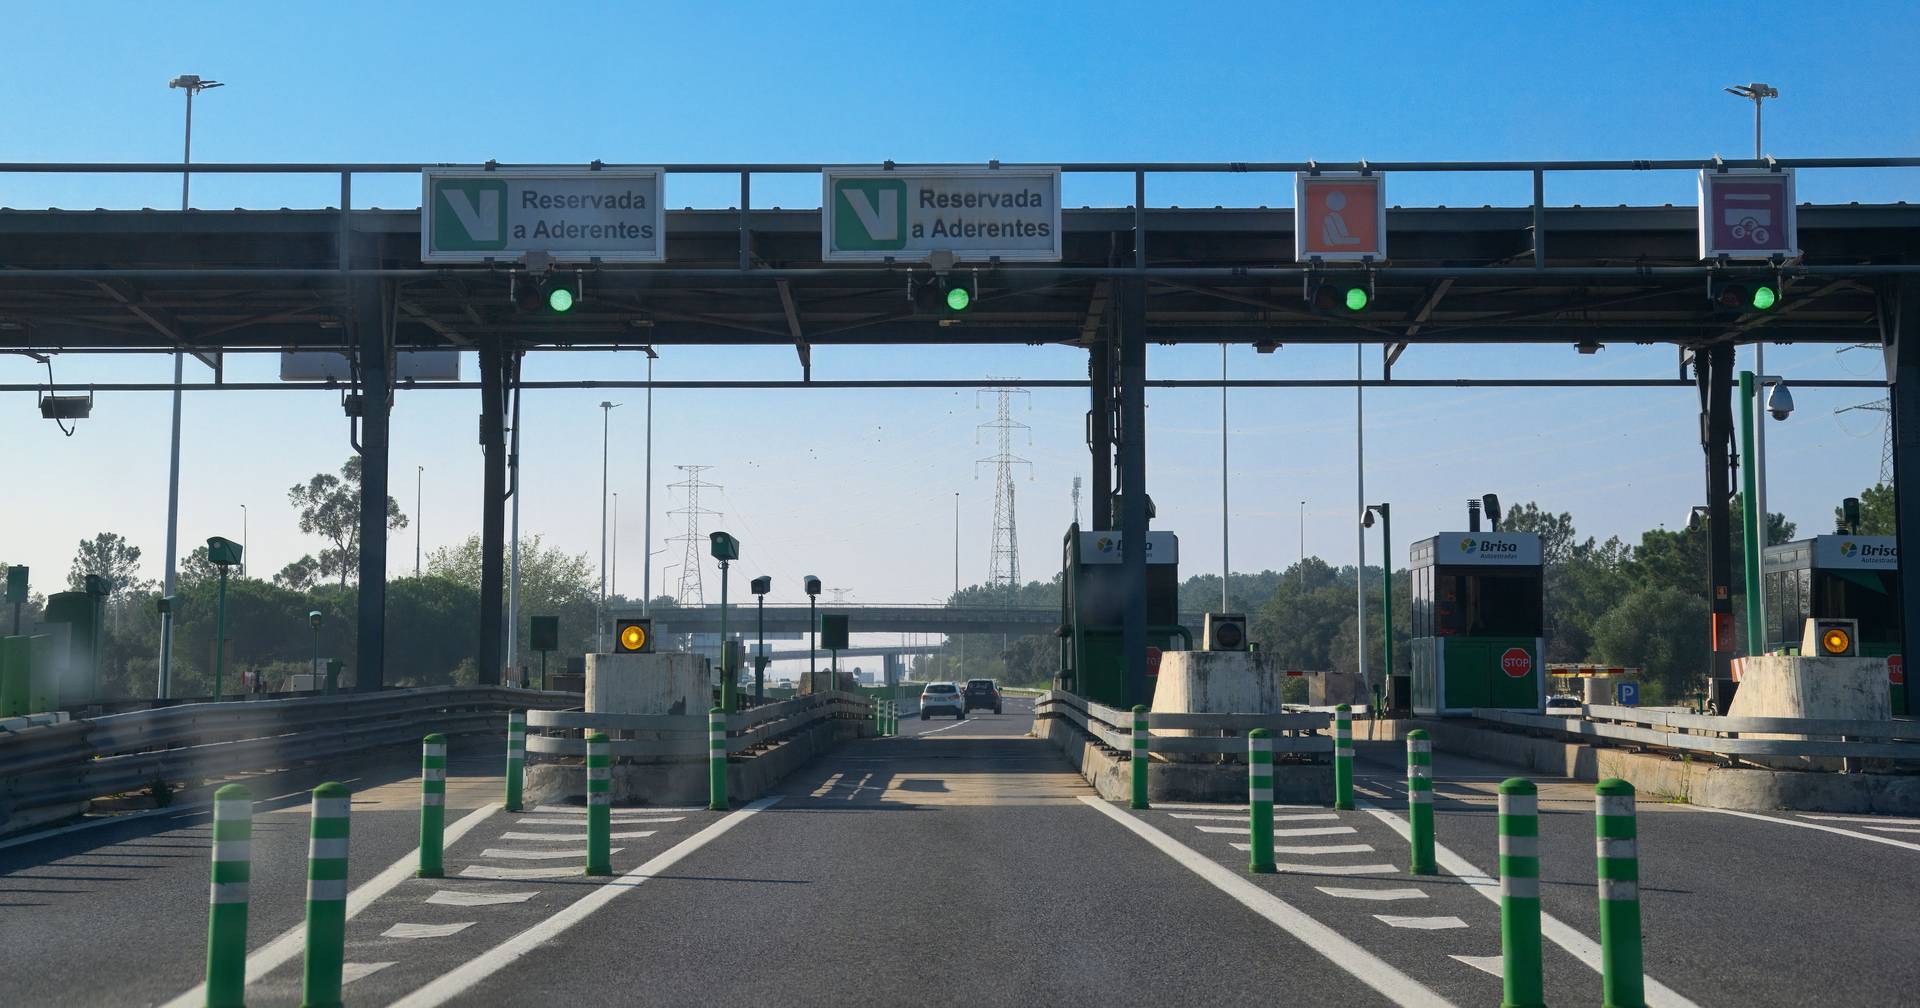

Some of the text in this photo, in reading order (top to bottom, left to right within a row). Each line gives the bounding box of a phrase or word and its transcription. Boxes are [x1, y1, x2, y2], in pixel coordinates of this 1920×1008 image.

[522, 190, 646, 210] Reservada
[919, 188, 1042, 209] Reservada
[513, 219, 653, 239] a Aderentes
[912, 218, 1050, 239] a Aderentes
[1480, 540, 1517, 552] Brisa
[1503, 657, 1529, 667] STOP
[1622, 685, 1634, 702] P
